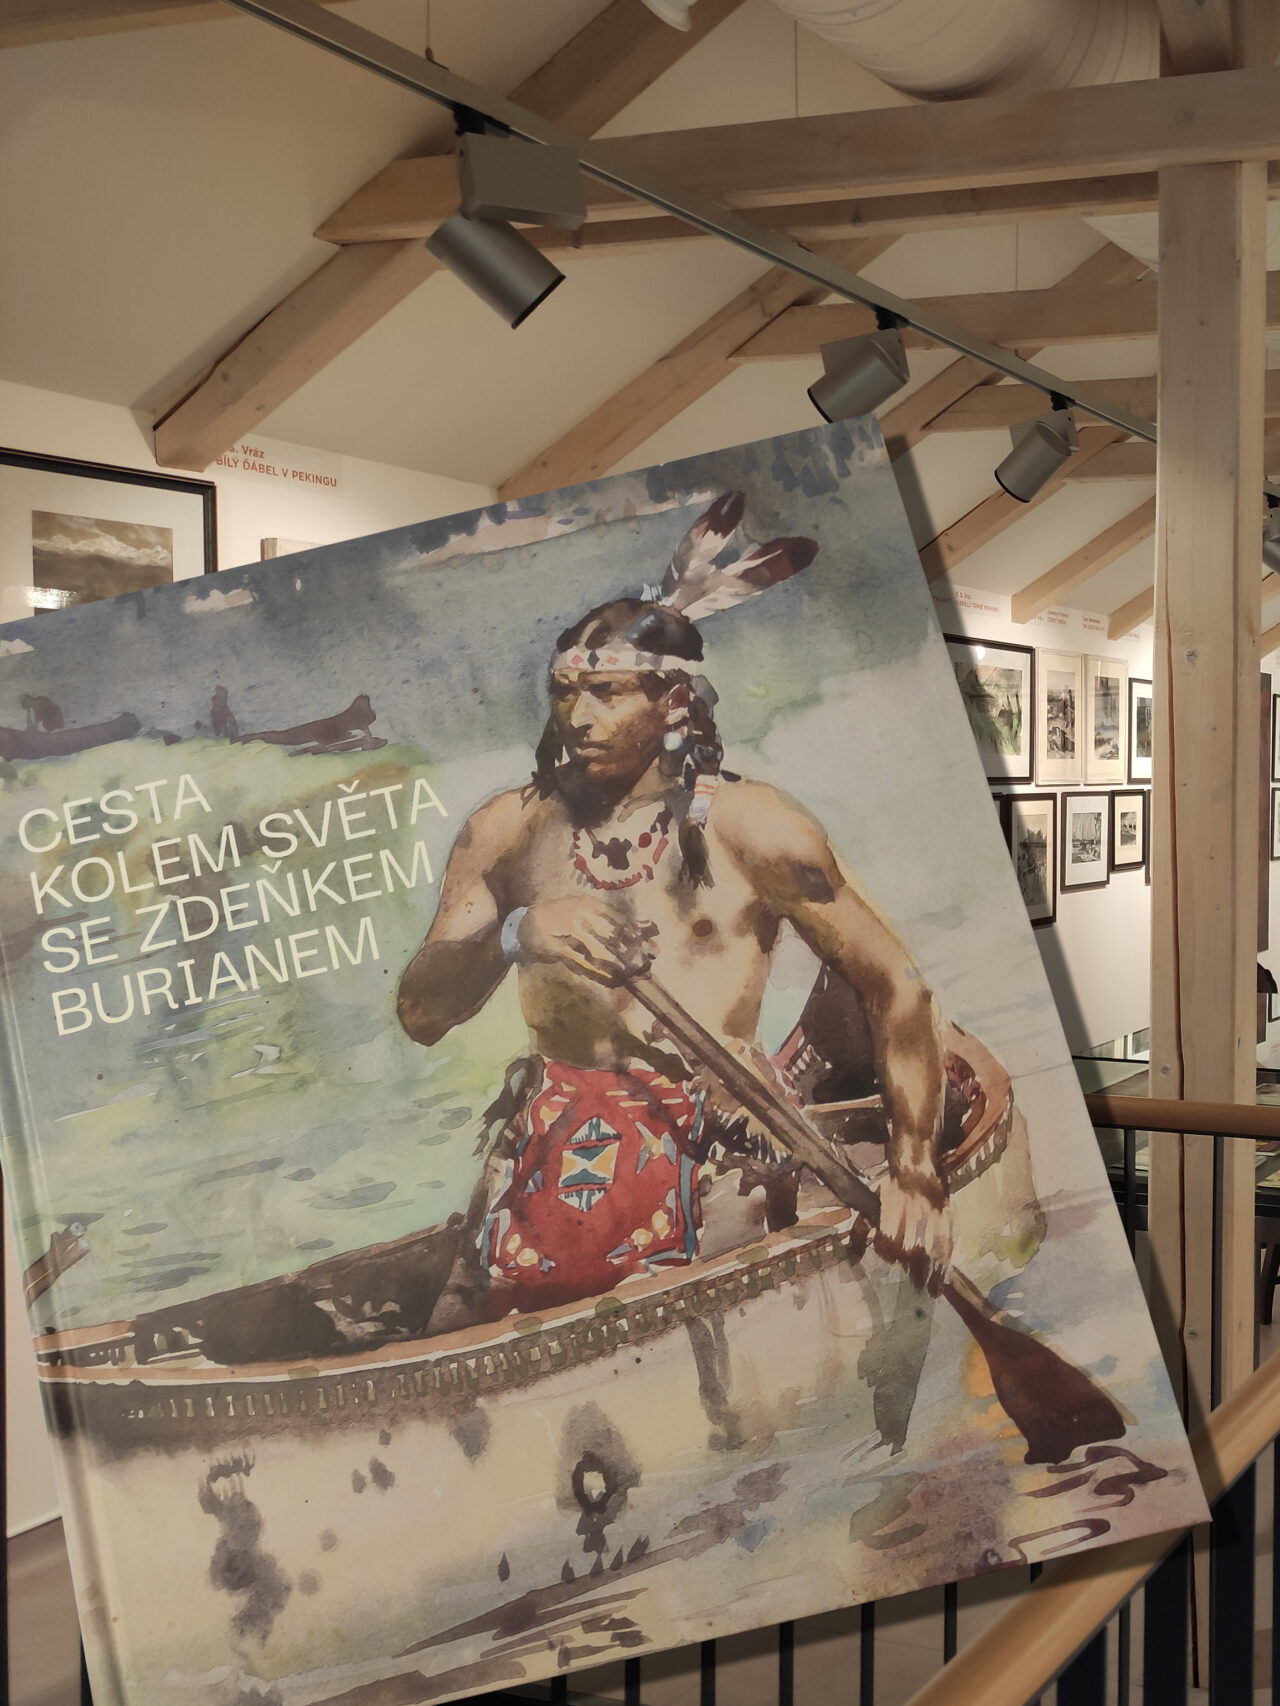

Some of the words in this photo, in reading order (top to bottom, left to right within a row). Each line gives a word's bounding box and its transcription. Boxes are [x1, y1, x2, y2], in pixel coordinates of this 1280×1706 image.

[242, 445, 265, 459] Vráz
[242, 458, 278, 476] ĎÁBEL
[282, 467, 289, 478] V
[292, 470, 337, 487] PEKINGU
[18, 773, 213, 854] CESTA
[29, 824, 242, 915] KOLEM
[258, 777, 449, 859] SVĚTA
[41, 916, 119, 974] SE
[135, 840, 435, 953] ZDEŇKEM
[51, 916, 381, 1036] BURIANEM
